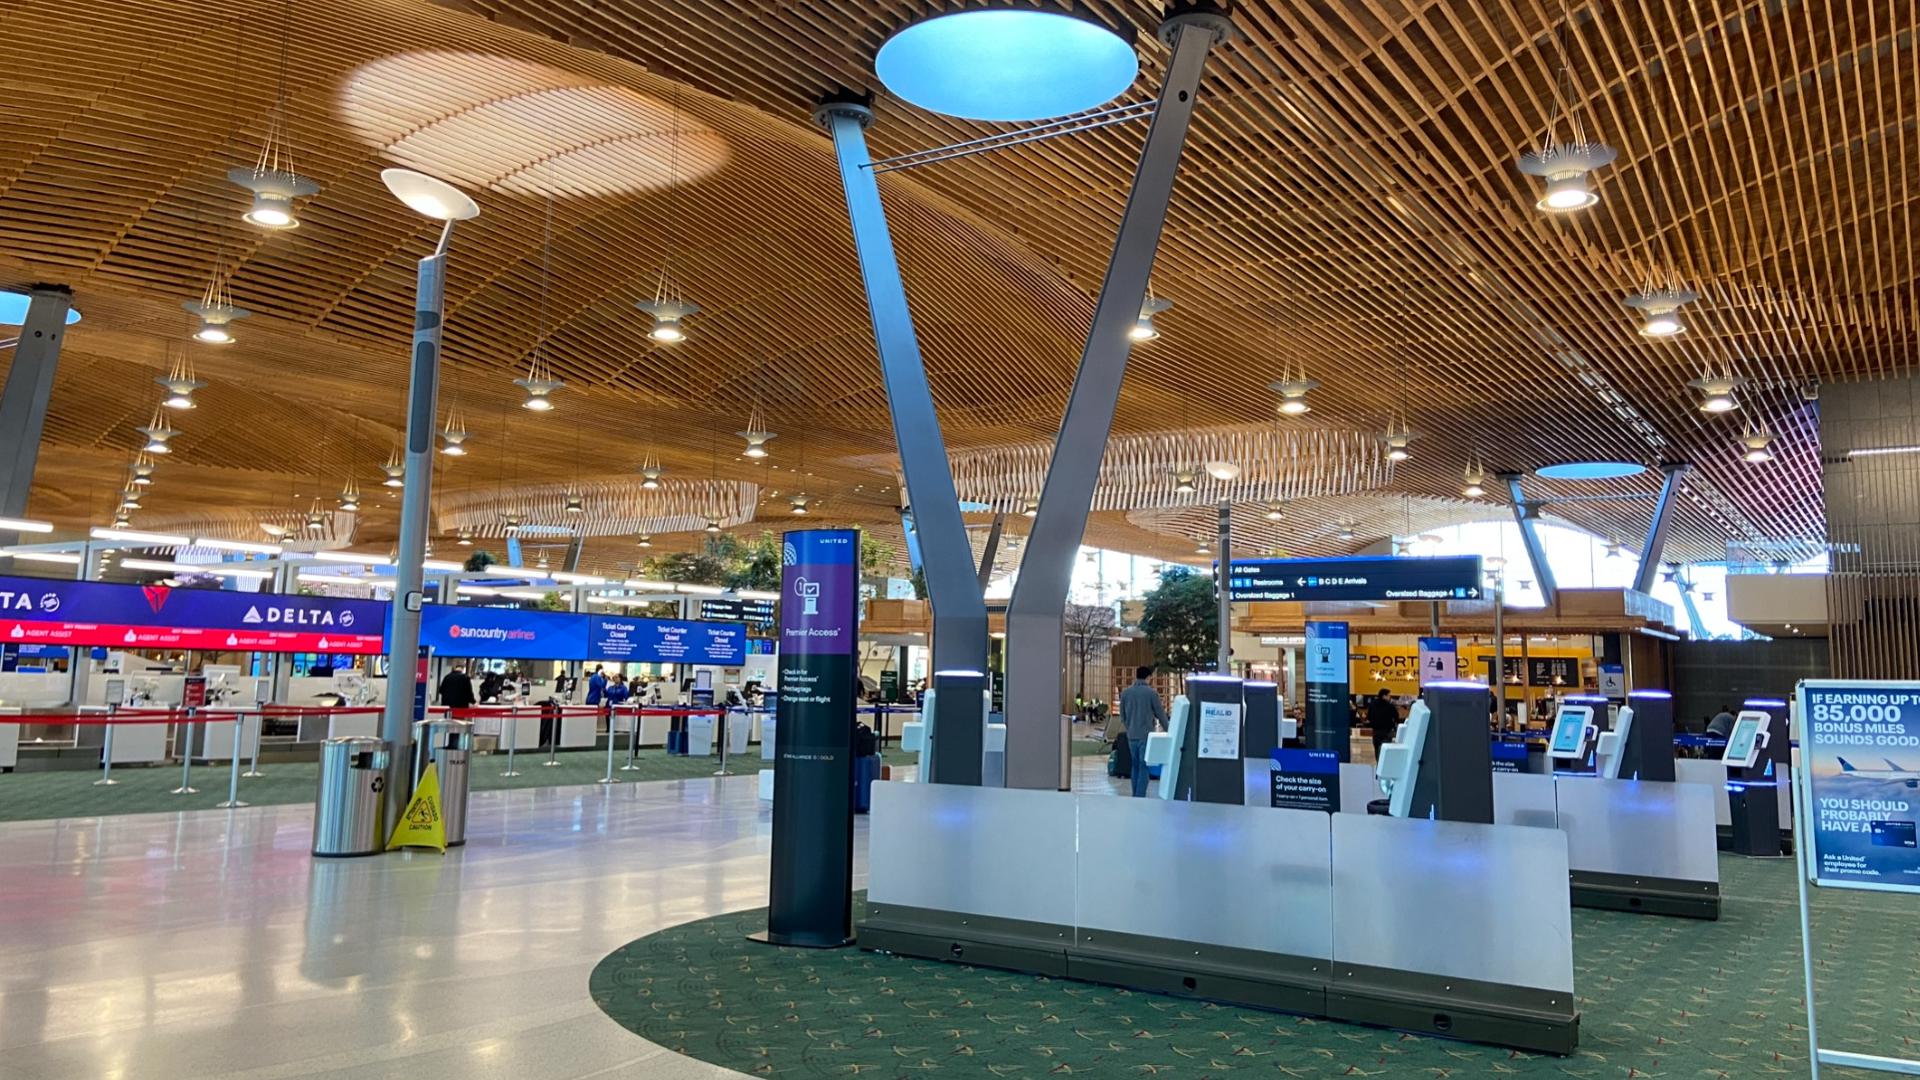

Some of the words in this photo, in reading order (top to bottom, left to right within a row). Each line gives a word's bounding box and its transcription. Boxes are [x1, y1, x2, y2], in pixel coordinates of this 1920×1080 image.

[1243, 566, 1260, 574] Gates
[1344, 577, 1368, 585] Arrivals
[1264, 592, 1290, 600] Baggage
[1418, 590, 1447, 598] Baggage
[267, 607, 334, 625] DELTA
[26, 629, 49, 637] AGENT
[50, 630, 72, 638] ASSIST
[785, 627, 807, 636] Premier
[137, 633, 159, 641] AGENT
[160, 634, 180, 642] ASSIST
[1812, 693, 1824, 704] IF
[1825, 694, 1888, 705] EARNING
[1890, 694, 1909, 705] UP
[1910, 695, 1920, 705] T
[1813, 704, 1901, 723] 85,000
[1814, 722, 1863, 734] BONUS
[1865, 723, 1906, 734] MILES
[1815, 733, 1874, 745] SOUNDS
[1275, 775, 1297, 783] Check
[1298, 785, 1327, 794] carry-on
[1820, 798, 1849, 809] YOU
[1850, 799, 1909, 812] SHOULD
[1820, 809, 1891, 821] PROBABLY
[1821, 820, 1860, 833] HAVE
[1861, 822, 1873, 833] A
[1824, 861, 1857, 869] employee
